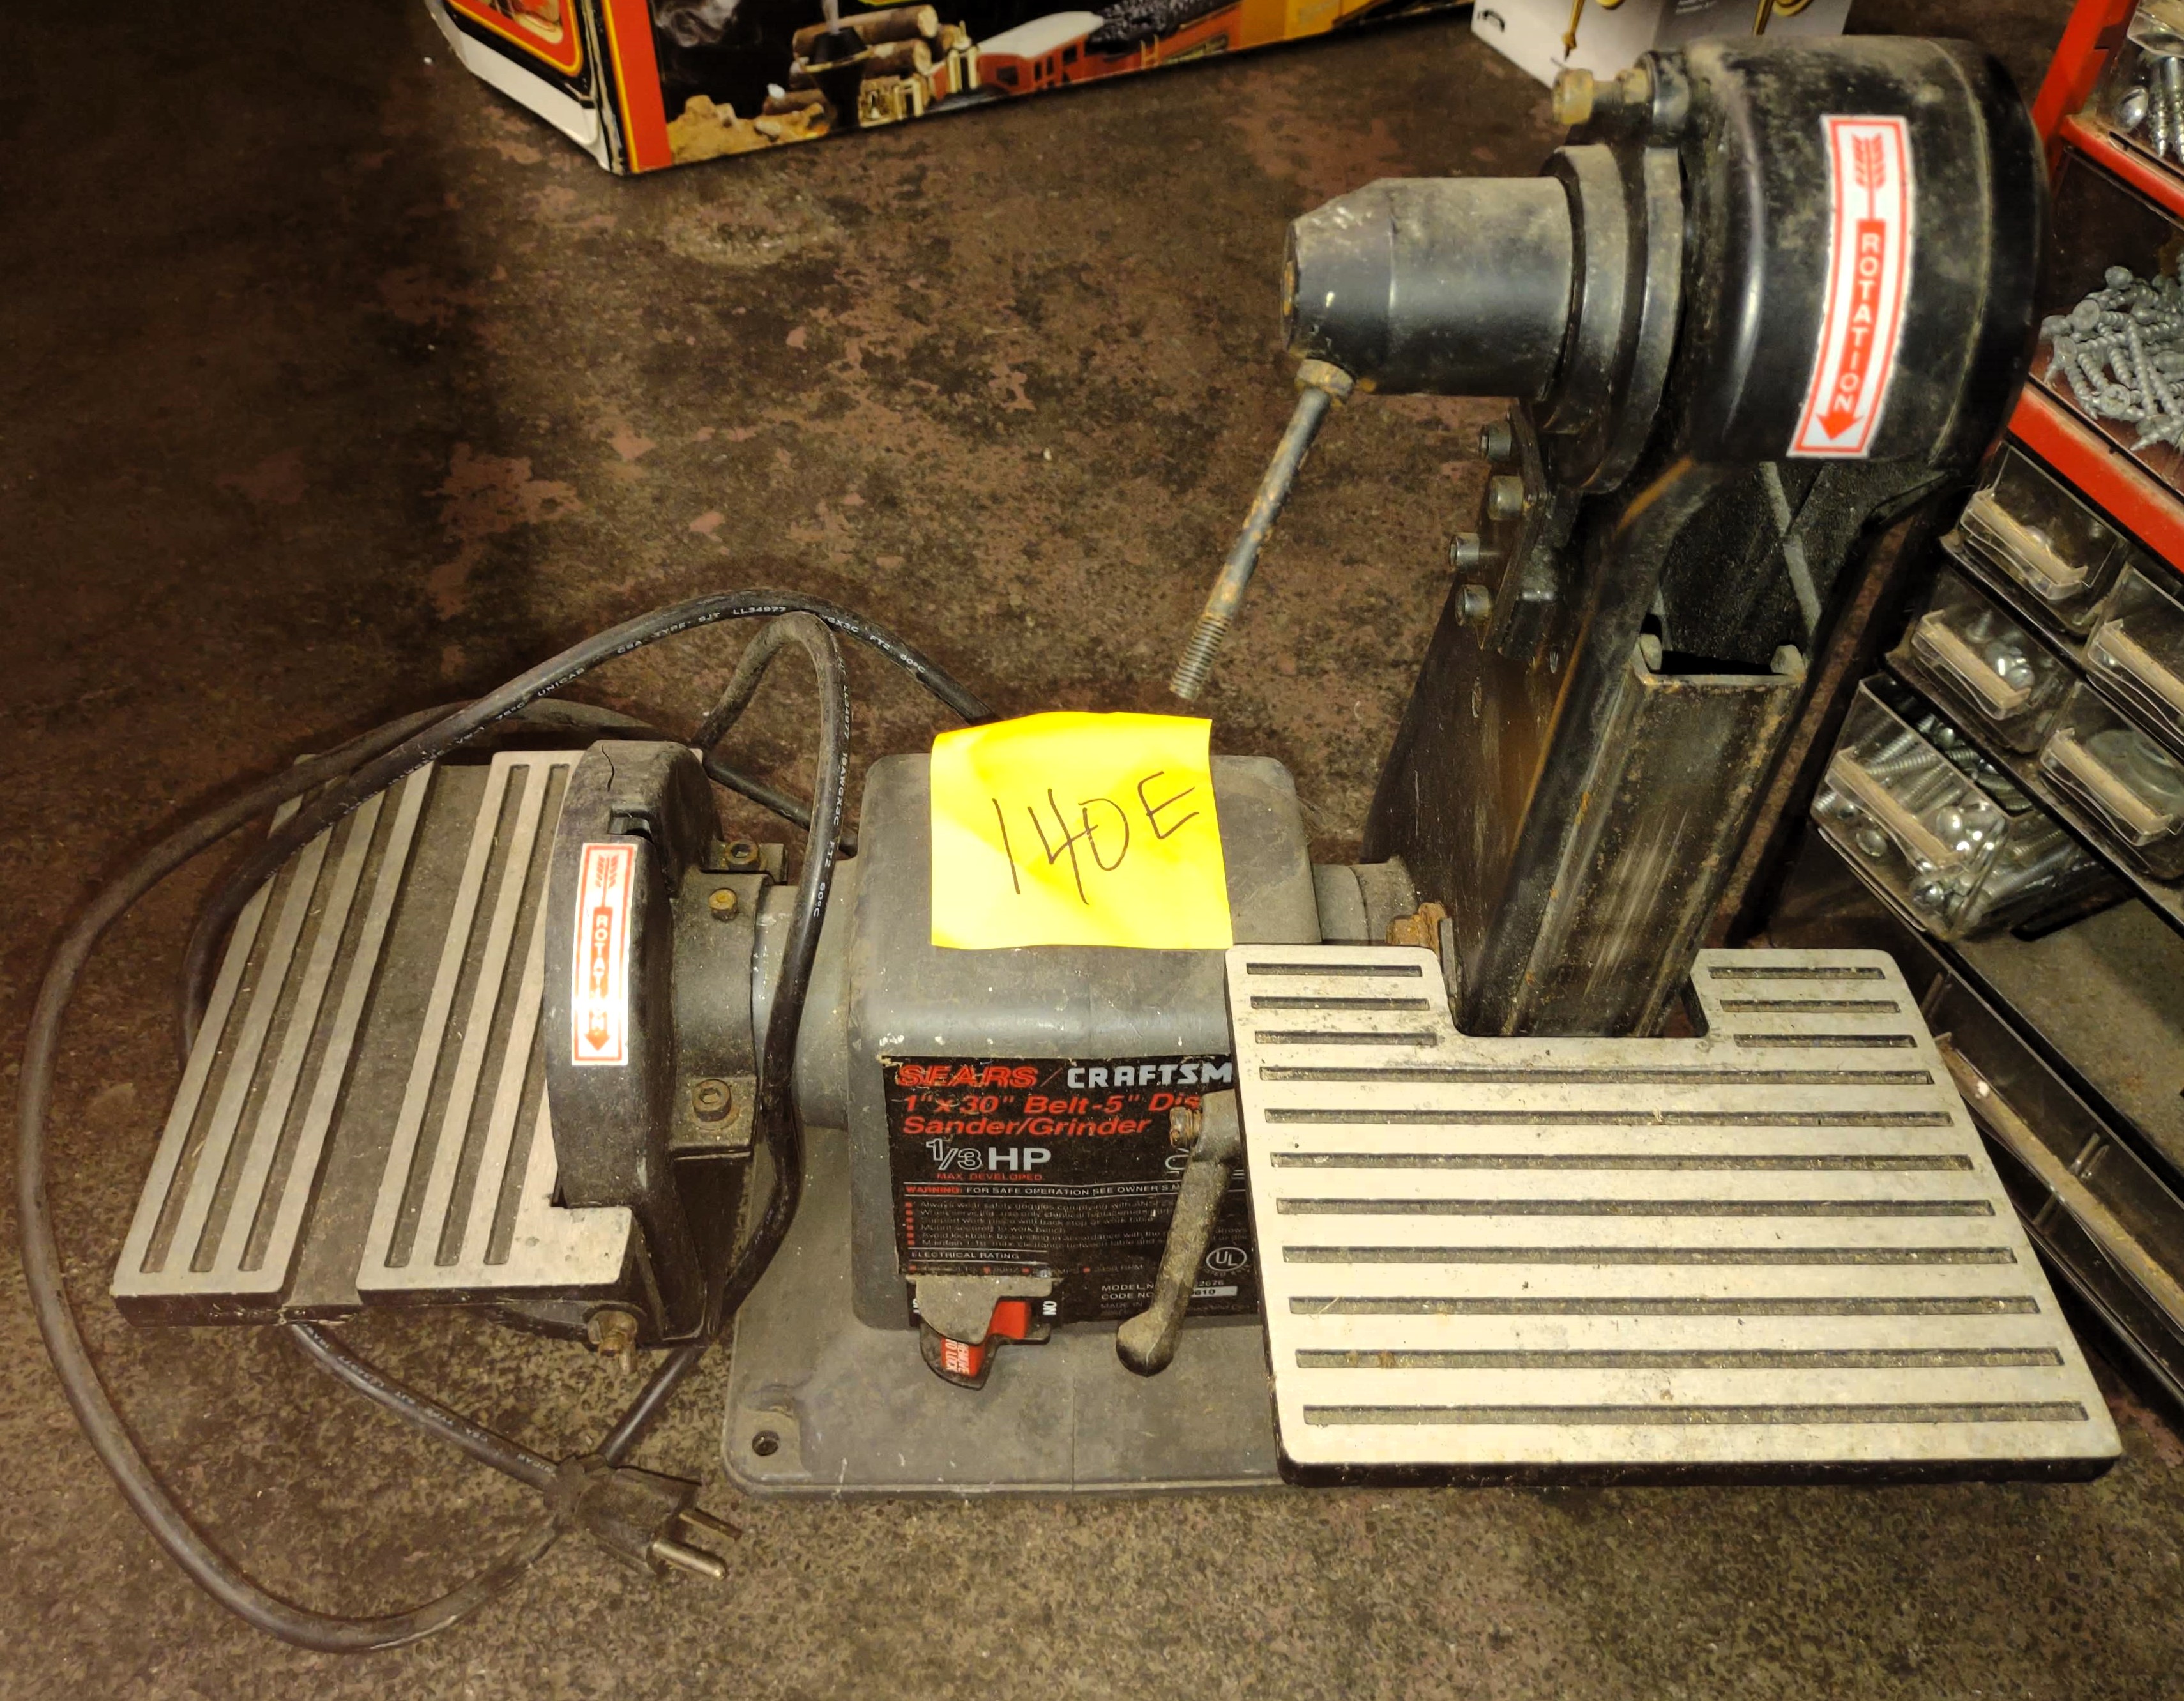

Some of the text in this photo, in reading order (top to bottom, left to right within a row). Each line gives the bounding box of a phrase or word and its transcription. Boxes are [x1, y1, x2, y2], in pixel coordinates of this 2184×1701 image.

[1833, 233, 1880, 413] ROTATION
[537, 667, 584, 697] UNICAB
[870, 635, 890, 650] FT2
[591, 914, 609, 1031] ROTATIN
[897, 1064, 1039, 1088] SEARS
[1067, 1062, 1232, 1088] CRAFTSM
[1148, 1092, 1202, 1112] Dis
[902, 1115, 1153, 1138] Sander/Grinder
[926, 1138, 1052, 1171] 1/3 HP
[1025, 1187, 1089, 1196] OPERATION
[1216, 1251, 1238, 1267] UL
[1042, 1300, 1057, 1316] ON
[945, 1351, 957, 1373] LOCK
